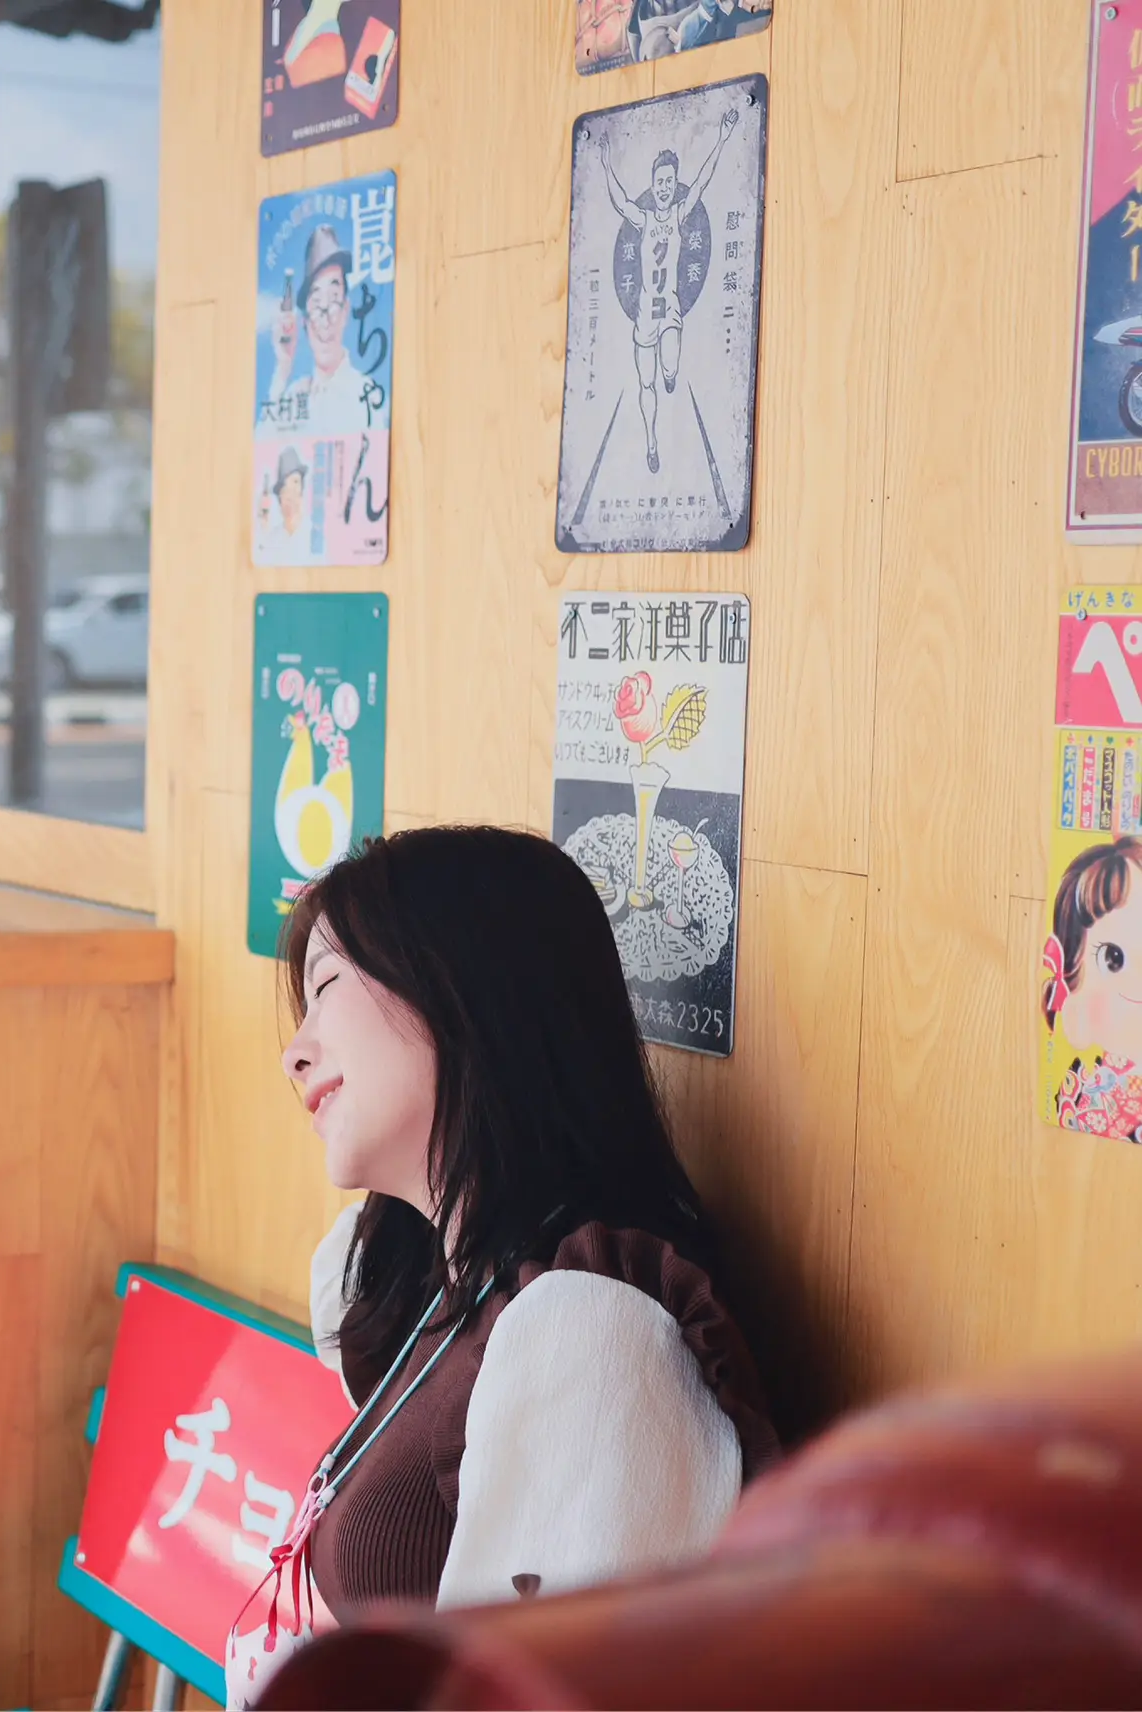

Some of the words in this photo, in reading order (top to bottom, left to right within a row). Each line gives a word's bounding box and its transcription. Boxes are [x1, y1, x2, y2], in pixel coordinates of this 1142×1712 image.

[651, 237, 669, 320] グリコ
[561, 601, 747, 664] 不二家洋菓子店
[558, 709, 614, 731] アイスクリーム
